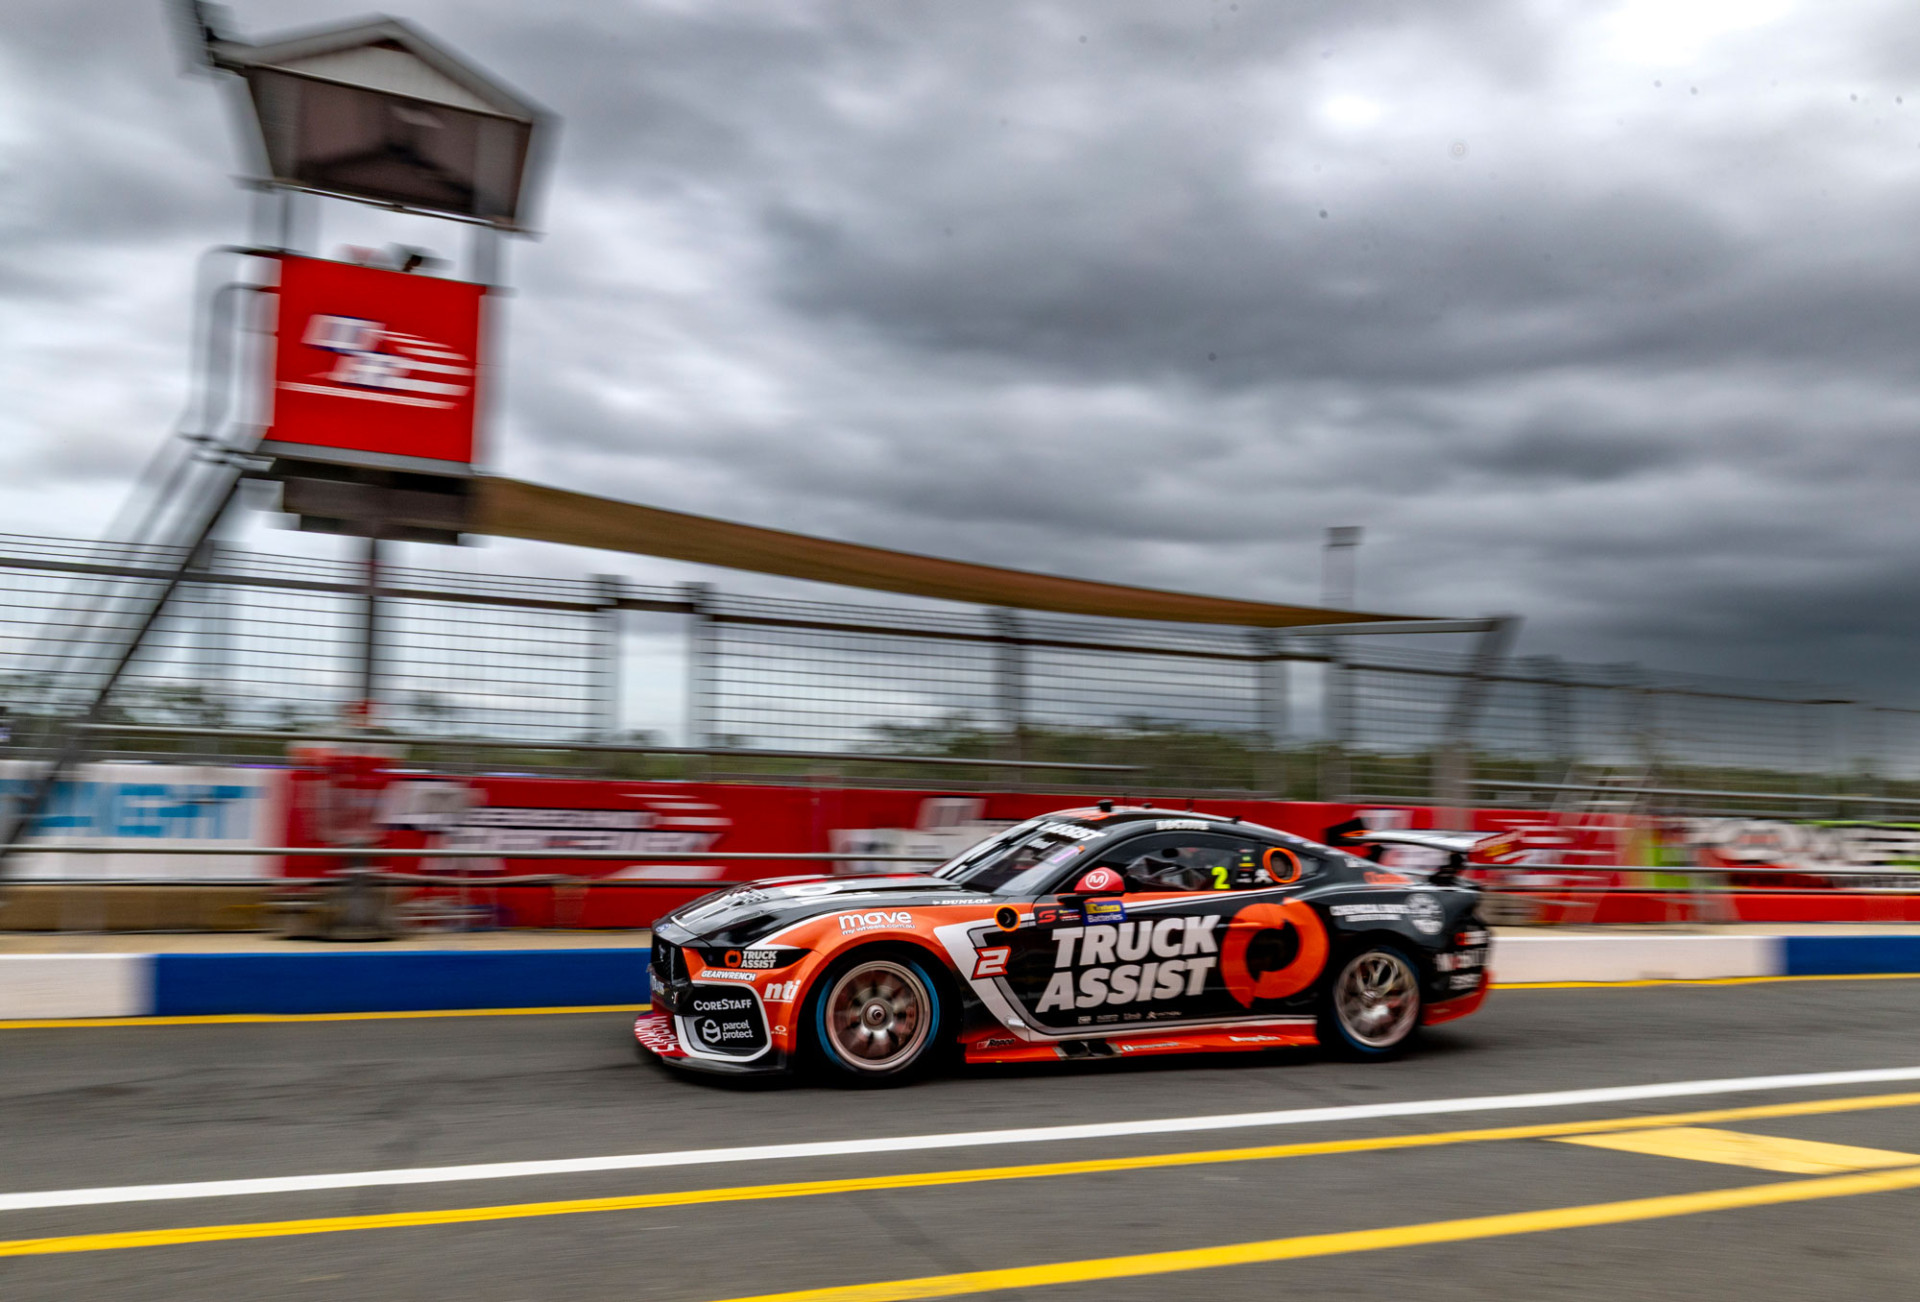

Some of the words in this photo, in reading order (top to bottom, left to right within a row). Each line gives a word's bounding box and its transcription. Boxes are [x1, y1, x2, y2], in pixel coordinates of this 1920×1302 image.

[1212, 866, 1231, 889] 2
[838, 911, 912, 929] move
[1052, 914, 1222, 968] TRUCK
[740, 959, 776, 969] ASSIST
[742, 950, 777, 960] TRUCK
[974, 947, 1010, 978] 2
[701, 970, 757, 981] GEARWRENCH
[1035, 956, 1218, 1013] ASSIST
[763, 980, 802, 1000] nti
[722, 1019, 750, 1030] parcel
[722, 1029, 754, 1041] protect
